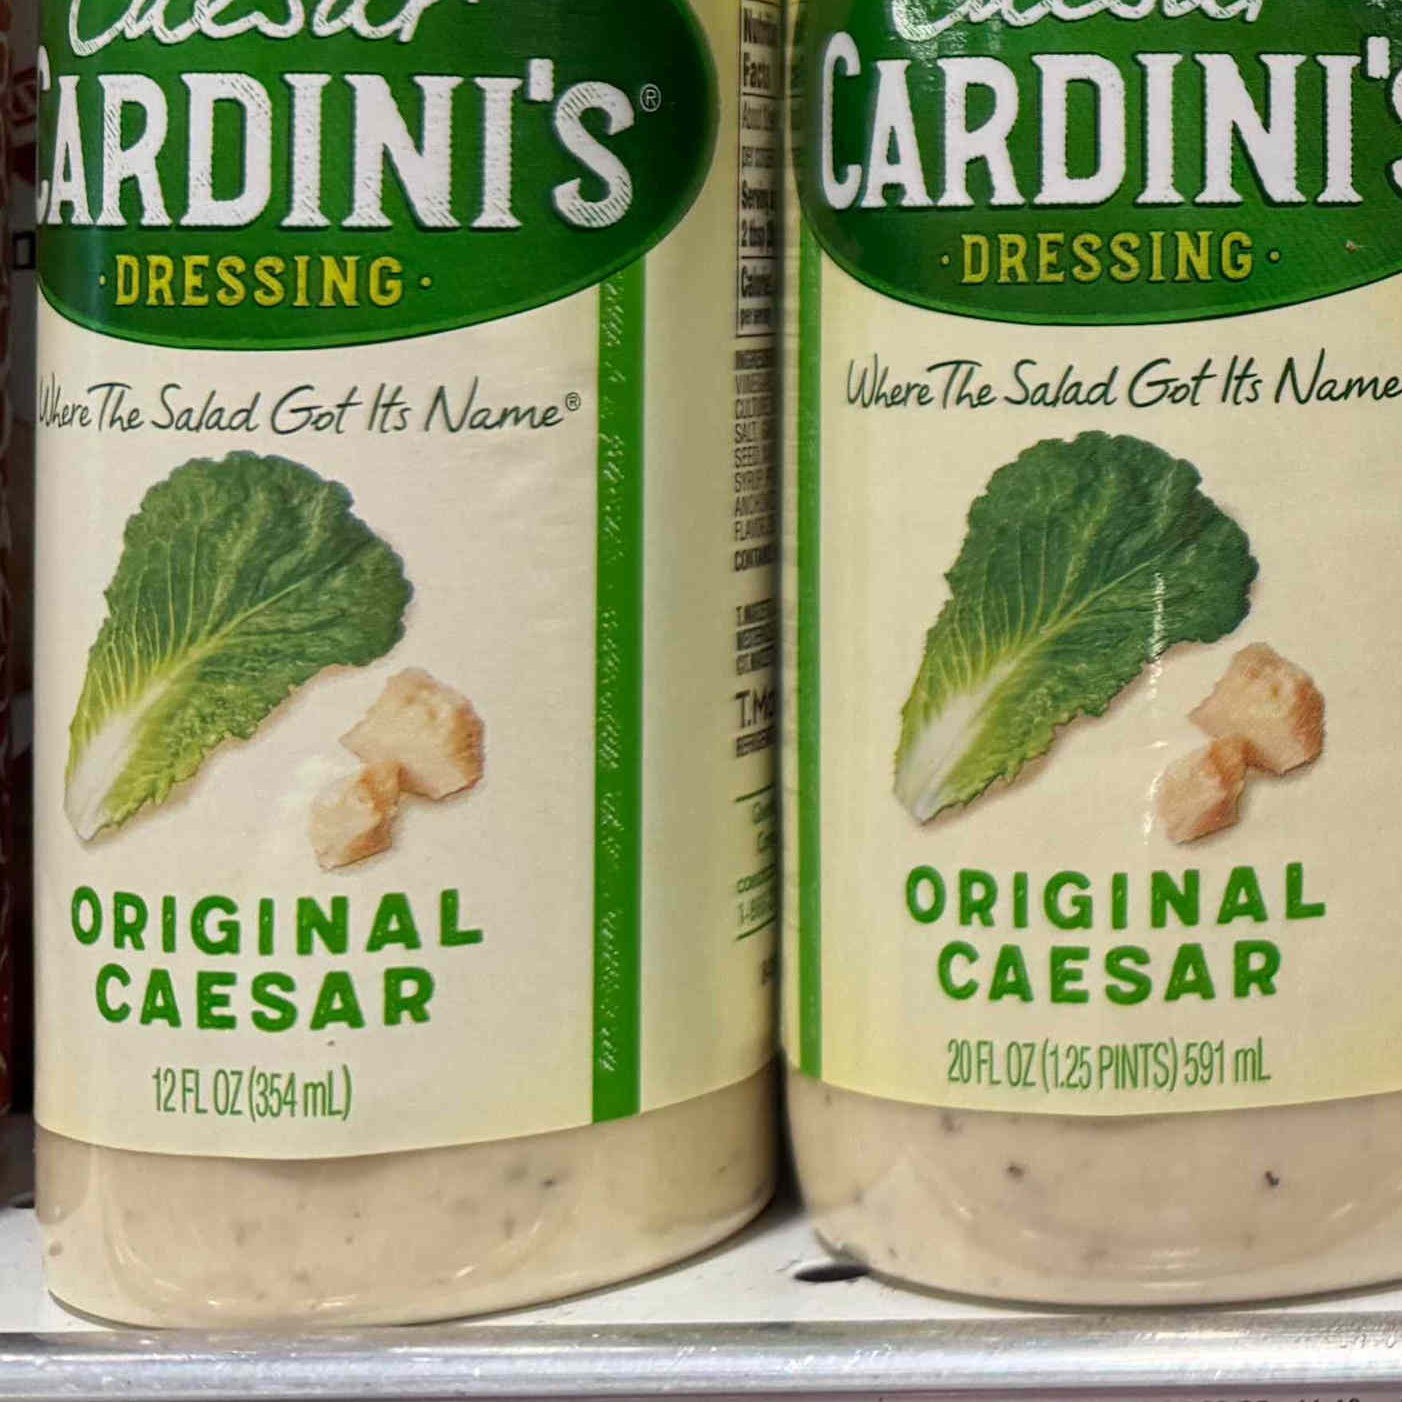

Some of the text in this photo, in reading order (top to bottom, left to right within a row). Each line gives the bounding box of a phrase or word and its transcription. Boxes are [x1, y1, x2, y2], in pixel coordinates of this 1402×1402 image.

[115, 254, 402, 308] DRESSING
[961, 230, 1253, 284] DRESSING
[38, 373, 92, 428] Where
[88, 381, 146, 432] The
[151, 381, 260, 433] Salad
[270, 385, 351, 434] Got
[367, 381, 411, 432] Its
[846, 357, 932, 410] Where
[930, 359, 997, 409] The
[1004, 358, 1118, 408] Salad
[1127, 362, 1212, 410] Got
[1220, 355, 1260, 407] Its
[70, 886, 484, 957] ORIGINAL
[904, 862, 1327, 931] ORIGINAL
[95, 964, 435, 1032] CAESAR
[937, 939, 1281, 1007] CAESAR
[152, 1064, 353, 1122] 12 FL OZ (354 mL)
[947, 1037, 1272, 1093] 20 FL OZ (1.25 PINTS) 591 mL
